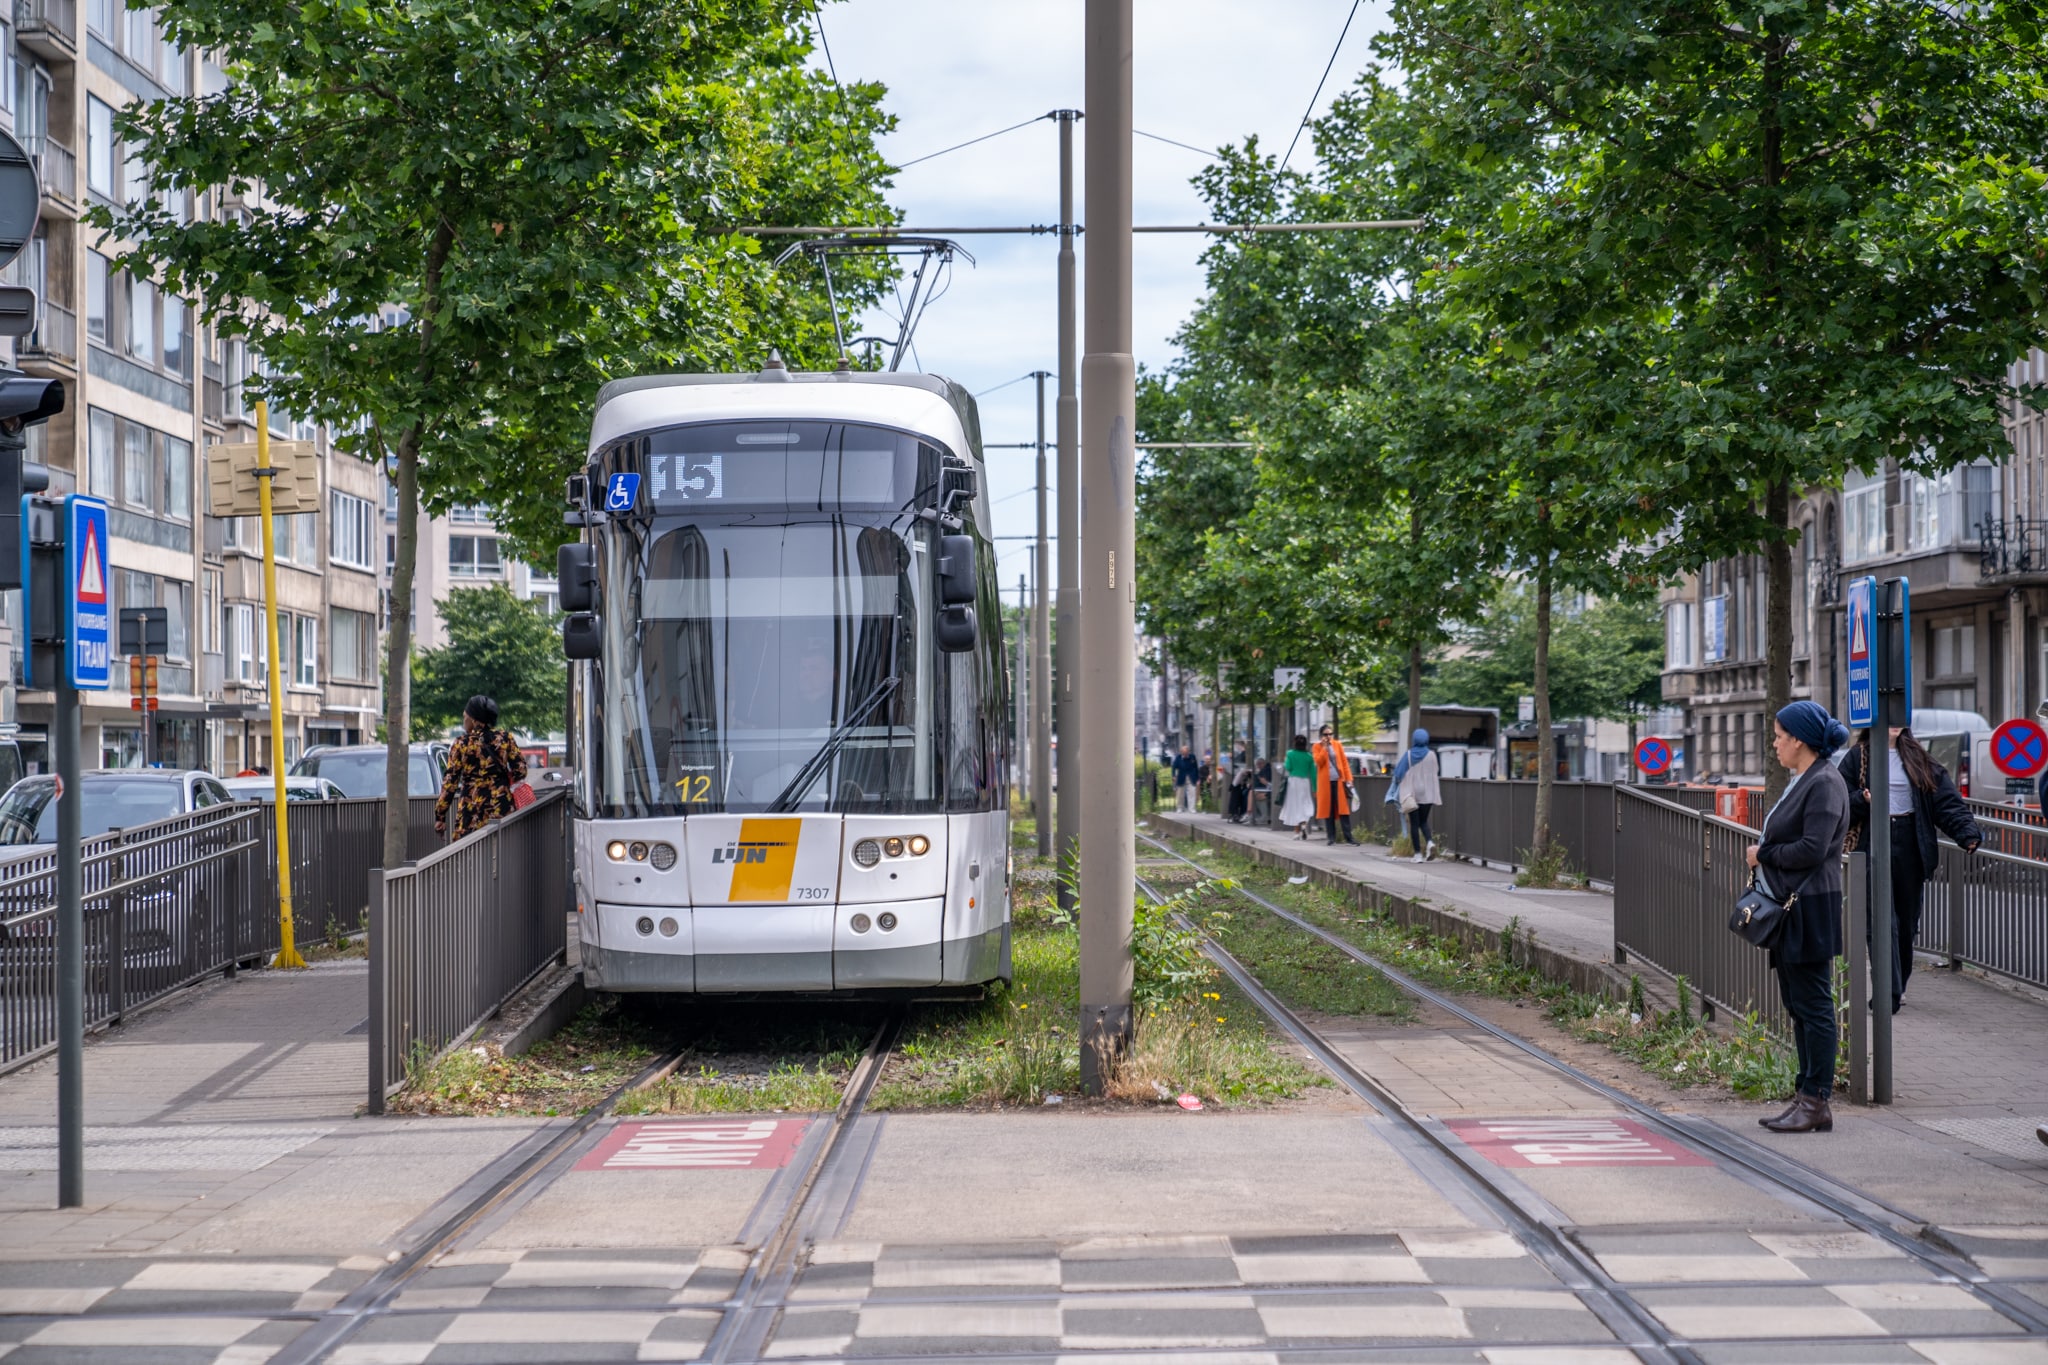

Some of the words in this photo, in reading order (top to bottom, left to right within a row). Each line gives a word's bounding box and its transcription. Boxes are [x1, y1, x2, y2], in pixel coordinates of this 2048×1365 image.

[654, 456, 720, 499] 15
[78, 640, 106, 668] TRAM
[1851, 688, 1869, 711] TRAM
[675, 775, 711, 803] 12
[797, 888, 830, 899] 7307
[602, 1121, 778, 1166] TRAM
[1479, 1120, 1676, 1164] TRAM
